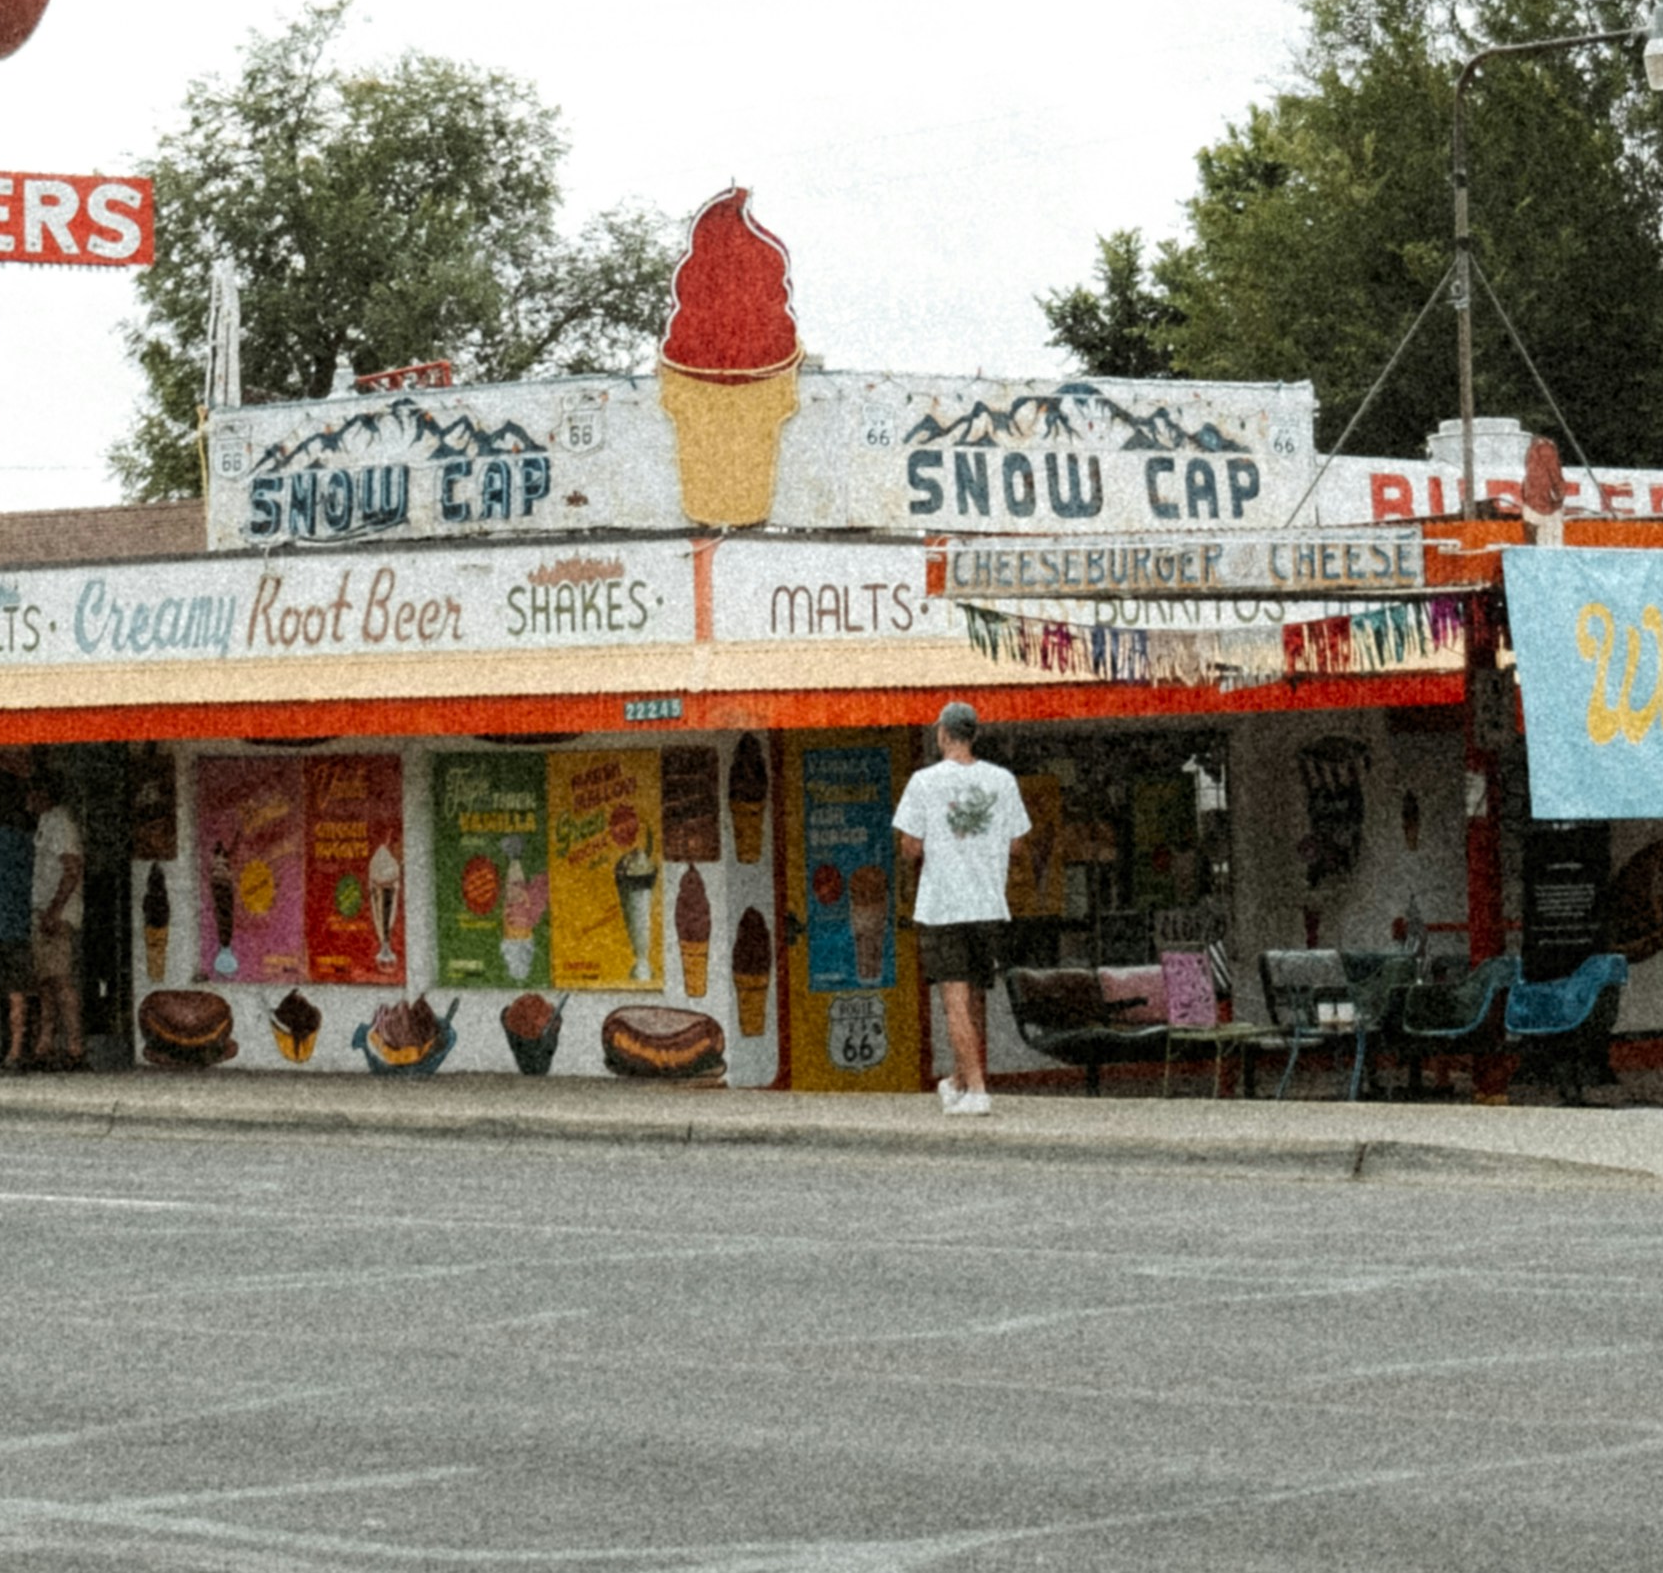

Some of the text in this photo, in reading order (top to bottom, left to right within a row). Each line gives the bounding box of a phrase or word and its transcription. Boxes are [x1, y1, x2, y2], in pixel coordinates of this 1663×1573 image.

[569, 425, 593, 446] 66
[867, 428, 890, 447] 66
[1273, 435, 1295, 454] 66
[222, 453, 242, 472] 66
[250, 456, 551, 536] SNOW CAP
[907, 449, 1260, 519] SNOW CAP
[952, 530, 1420, 590] CHEESEBURGER CHEESE
[73, 580, 235, 658] Creamy
[248, 569, 353, 648] Root
[362, 568, 464, 644] Beer
[506, 580, 648, 636] SHAKES
[771, 583, 913, 634] MALTS
[842, 1034, 874, 1064] 66
